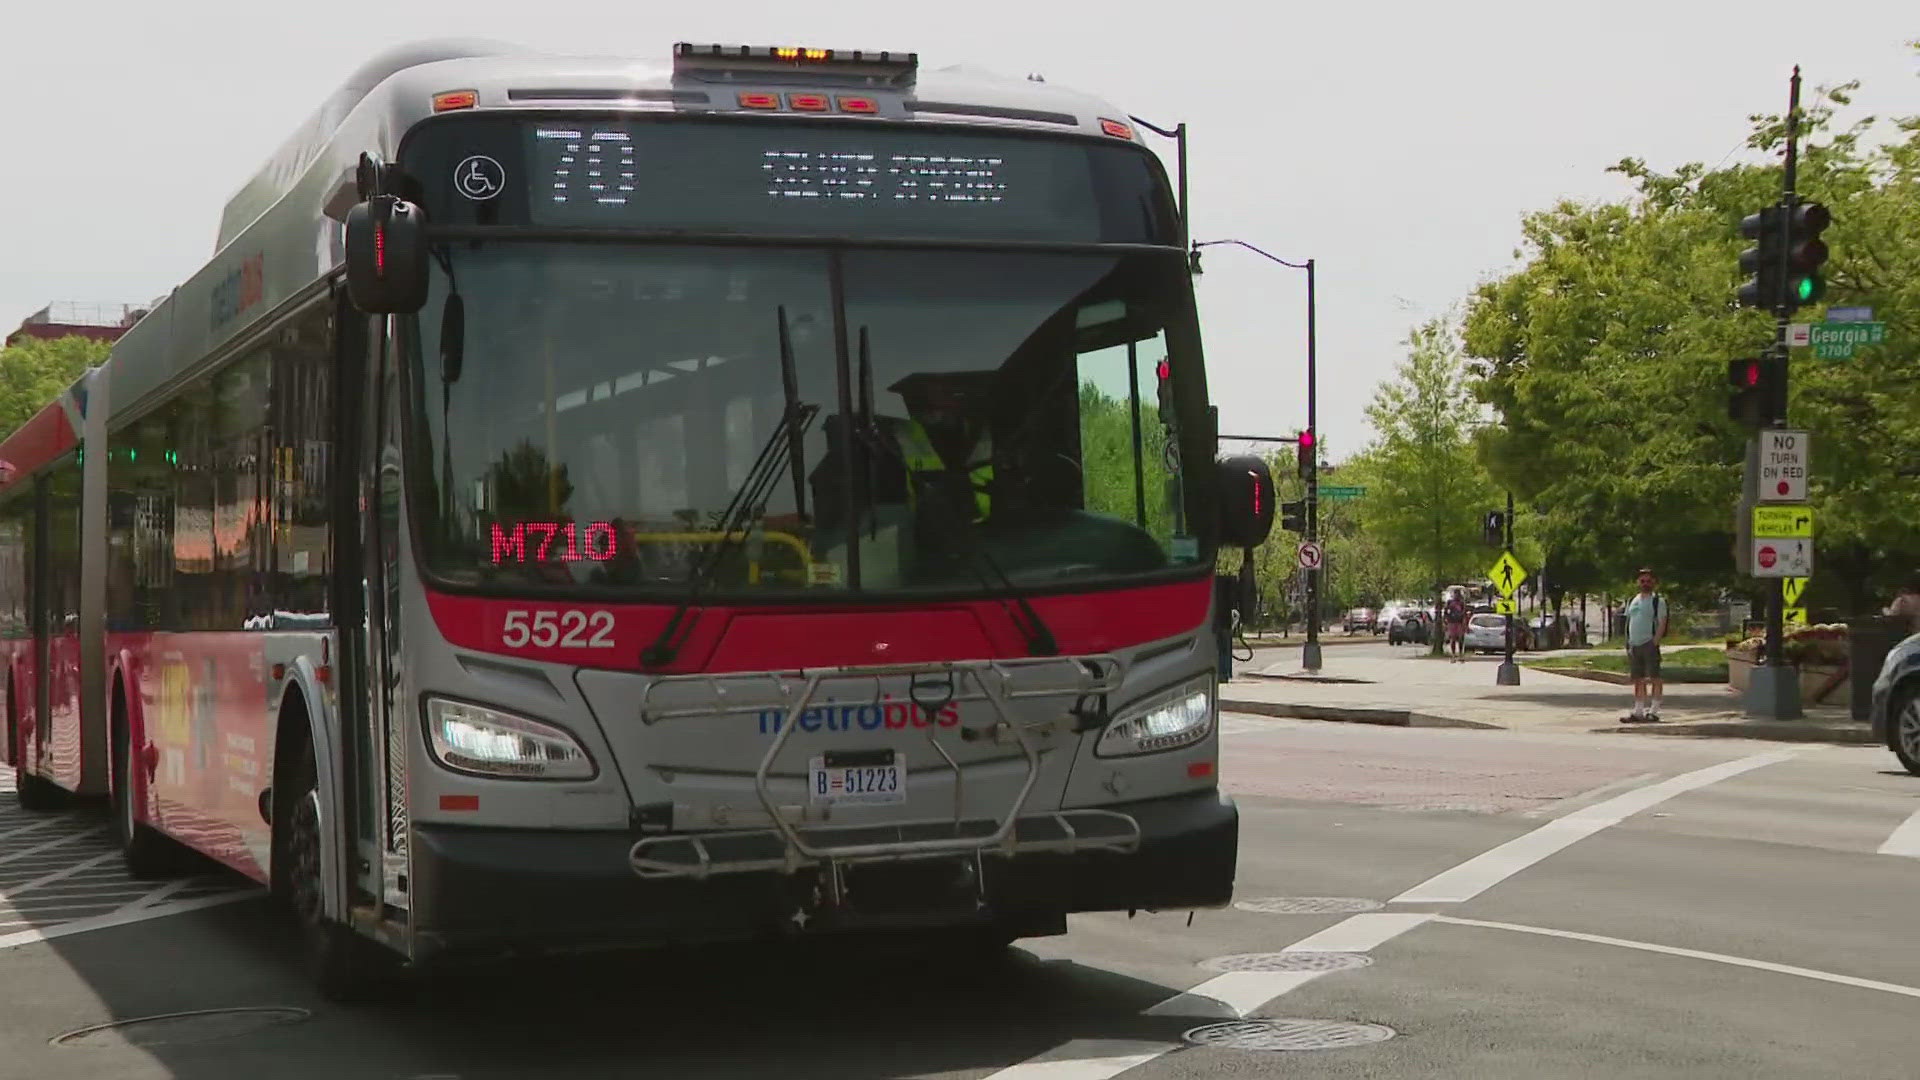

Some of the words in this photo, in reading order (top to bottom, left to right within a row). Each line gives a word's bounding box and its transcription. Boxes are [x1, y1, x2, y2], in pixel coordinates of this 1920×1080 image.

[537, 129, 635, 204] 70
[1811, 327, 1868, 345] Georgia
[1774, 435, 1795, 450] NO
[1769, 452, 1798, 465] TURN
[1763, 467, 1778, 479] ON
[1782, 467, 1804, 479] RED
[1758, 511, 1792, 520] TURNING
[492, 520, 617, 563] M710
[502, 609, 616, 649] 5522
[845, 766, 898, 794] 51223
